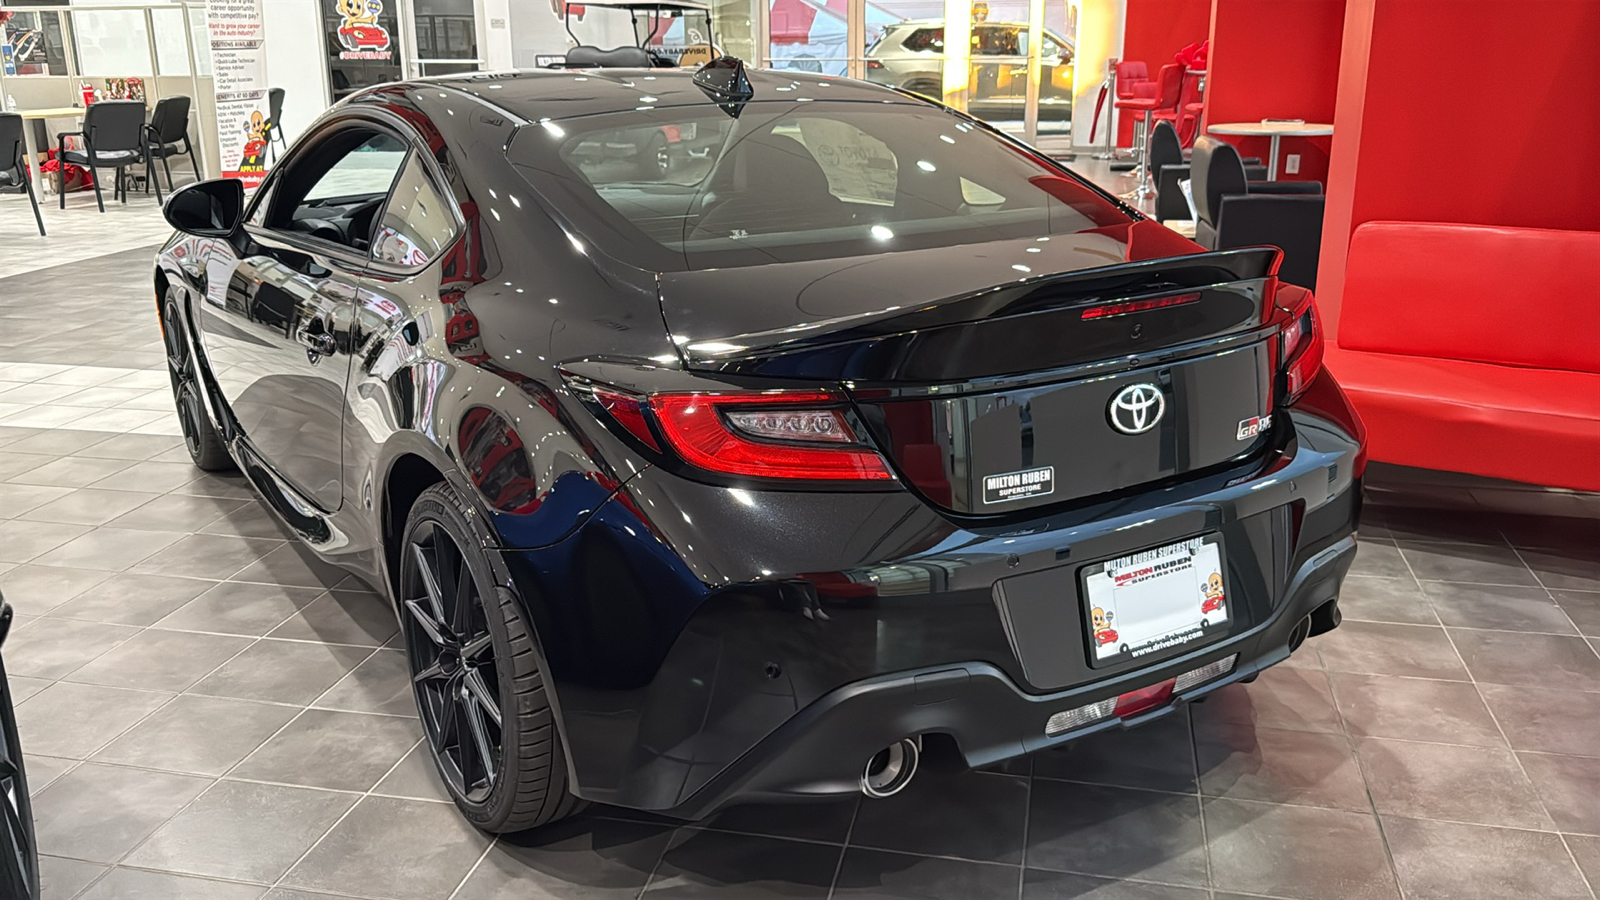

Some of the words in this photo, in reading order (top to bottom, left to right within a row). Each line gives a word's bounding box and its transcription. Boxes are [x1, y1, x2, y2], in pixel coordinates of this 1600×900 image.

[220, 12, 247, 20] competitive
[248, 12, 259, 20] pay?
[987, 474, 1020, 490] MILTON
[1021, 469, 1050, 485] RUBEN
[999, 483, 1042, 496] SUPERSTORE
[1103, 556, 1132, 573] MILTON
[1132, 549, 1158, 564] RUBEN
[1158, 537, 1204, 557] SUPERSTORE
[1114, 566, 1153, 582] MILTON
[1153, 556, 1192, 572] RUBEN
[1131, 563, 1193, 584] SUPERSTORE
[1131, 630, 1204, 658] www.drivebaby.com
